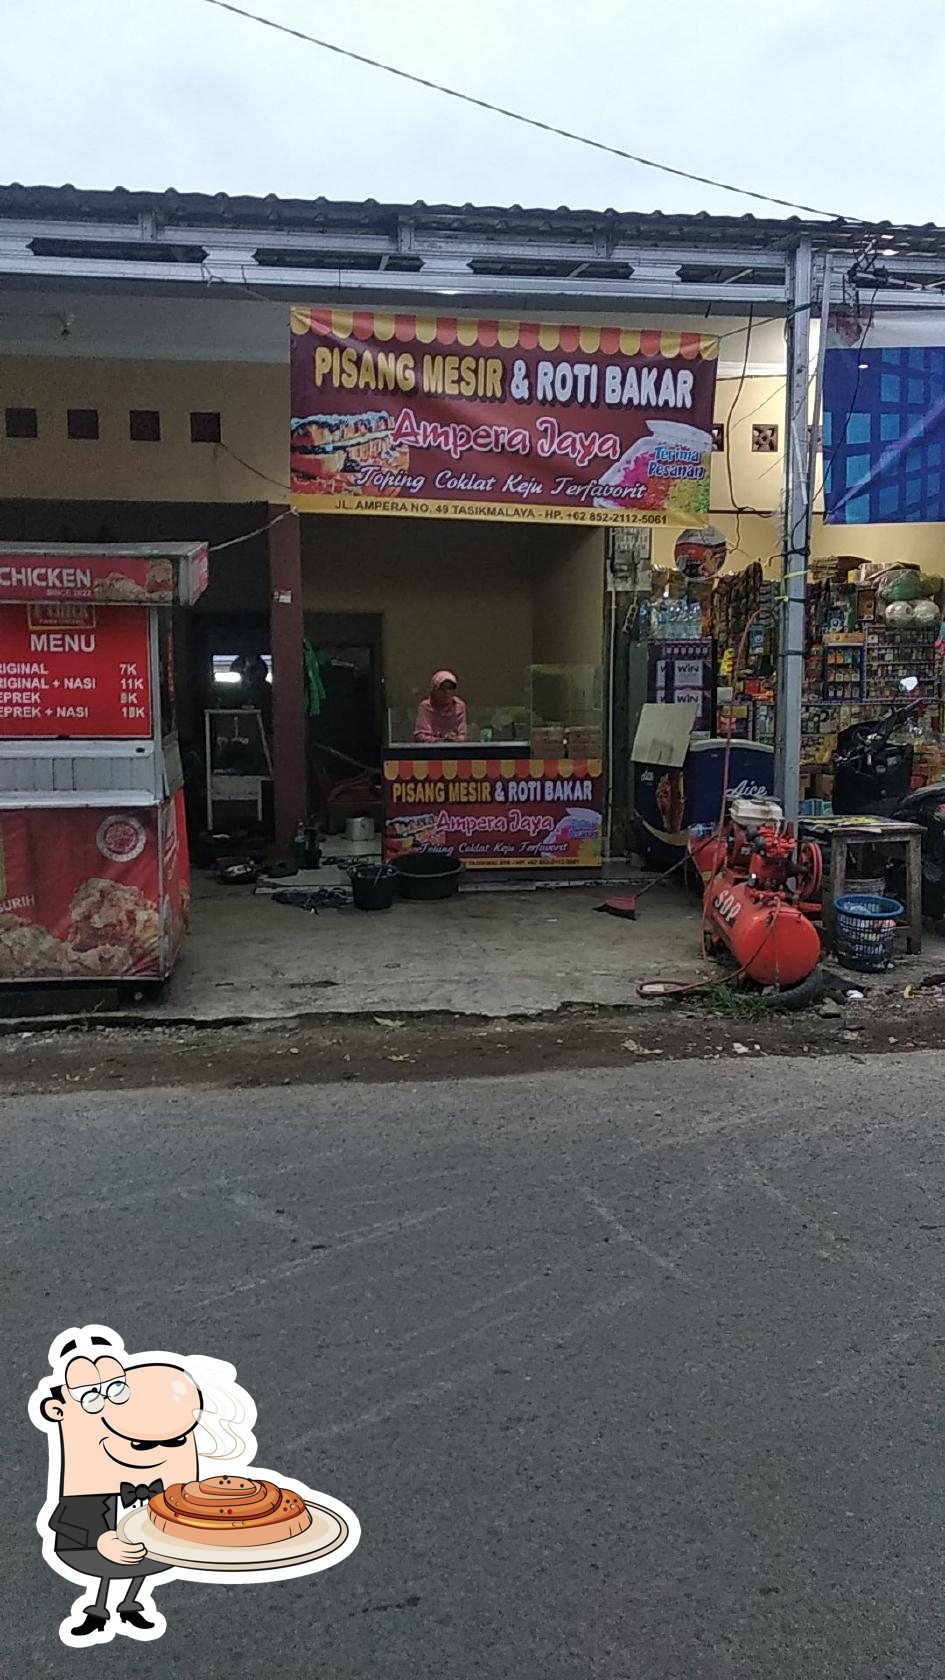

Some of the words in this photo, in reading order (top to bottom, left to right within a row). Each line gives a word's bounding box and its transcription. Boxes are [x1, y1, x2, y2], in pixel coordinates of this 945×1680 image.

[315, 347, 415, 391] PISANG
[423, 354, 502, 398] MESIR
[511, 359, 529, 400] &
[536, 361, 598, 403] ROTI
[605, 366, 694, 409] BAKAR
[390, 408, 530, 459] Ampera
[536, 417, 620, 466] Jaya
[655, 446, 699, 462] Terima
[648, 462, 705, 478] Pesanan
[357, 465, 425, 493] Toping
[435, 470, 497, 491] Coklat
[502, 475, 543, 498] Keju
[551, 477, 647, 502] Terfavorit
[335, 500, 353, 510] JL.
[356, 501, 407, 512] AMPERA
[411, 503, 432, 514] NO.
[435, 504, 449, 514] 49
[451, 504, 535, 518] TASIKMALAYA
[545, 511, 563, 520] HP.
[566, 513, 586, 521] +62
[589, 513, 667, 525] 852-2112-5061
[0, 567, 91, 588] CHICKEN
[31, 634, 95, 652] MENU
[120, 663, 137, 675] 7K
[52, 679, 60, 688] +
[64, 678, 96, 689] NASI
[120, 678, 144, 690] 11K
[45, 708, 53, 716] +
[57, 707, 88, 718] NASI
[392, 782, 446, 803] PISANG
[448, 782, 491, 802] MESIR
[494, 781, 505, 802] &
[508, 780, 541, 802] ROTI
[544, 780, 593, 801] BAKAR
[726, 780, 768, 798] Aice
[434, 809, 507, 837] Ampera
[509, 809, 555, 837] Jaya
